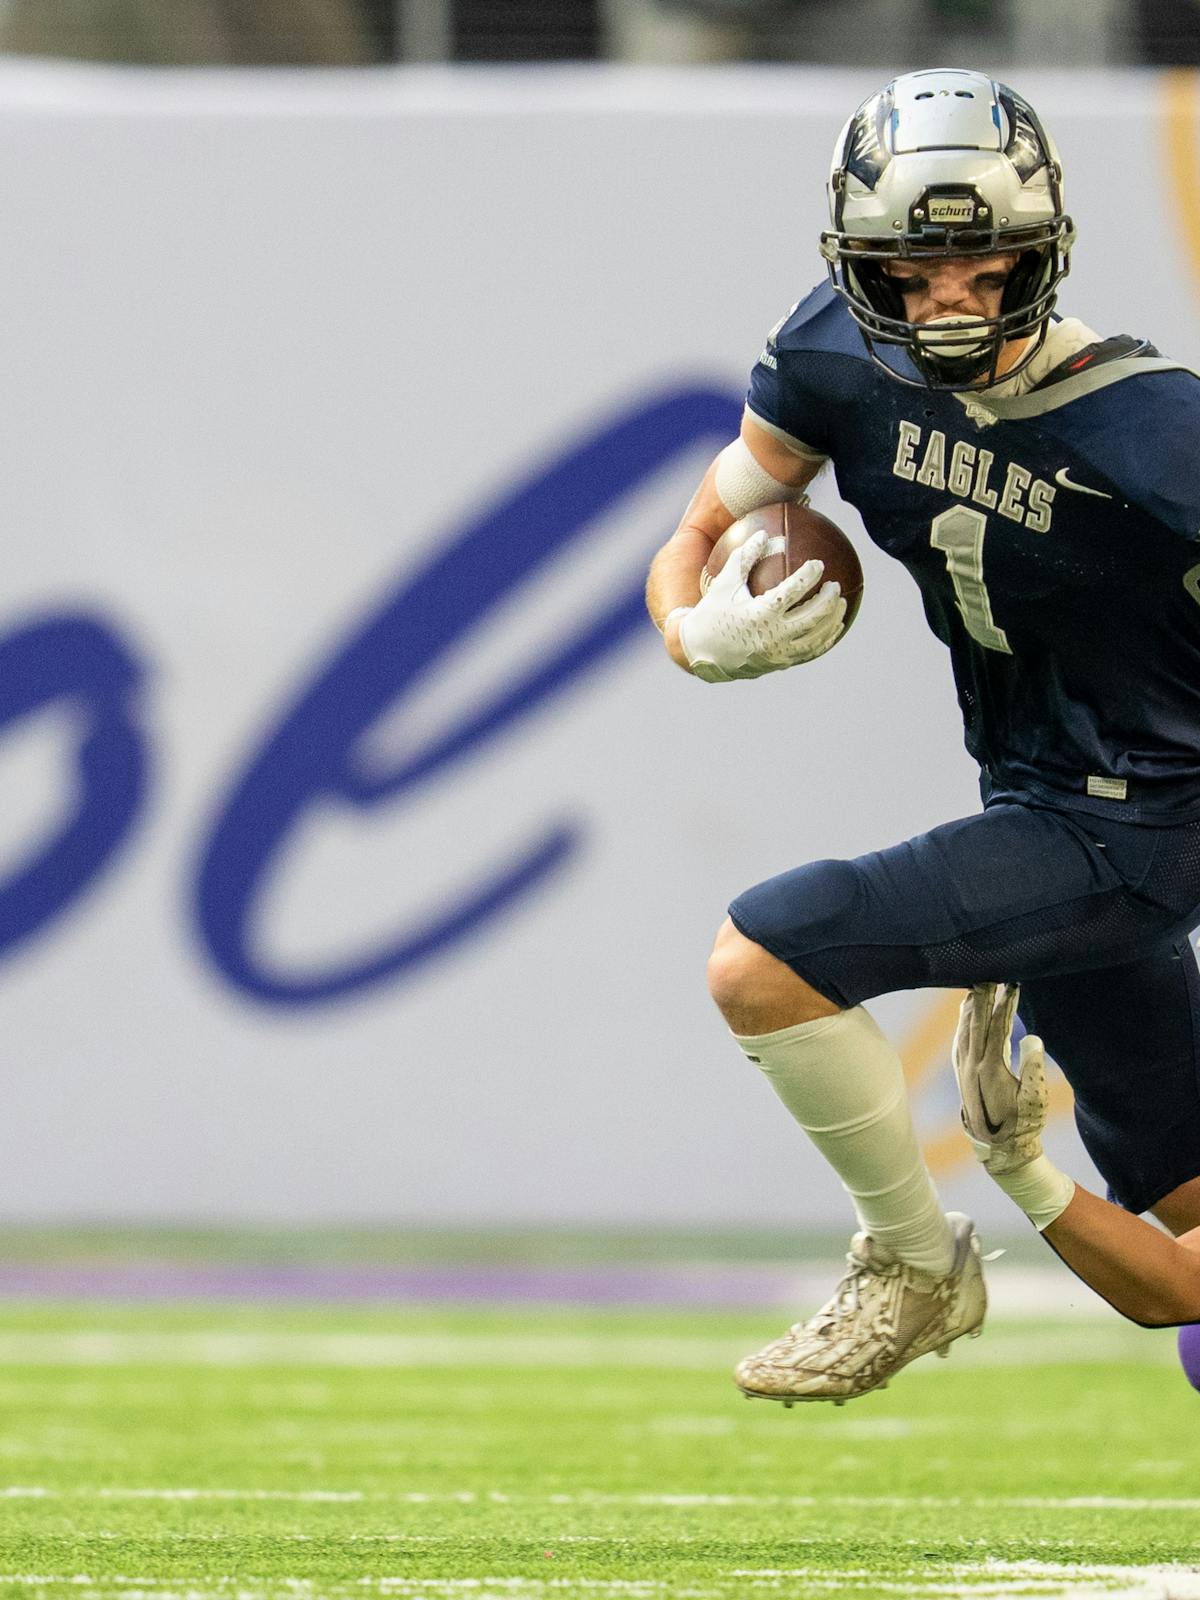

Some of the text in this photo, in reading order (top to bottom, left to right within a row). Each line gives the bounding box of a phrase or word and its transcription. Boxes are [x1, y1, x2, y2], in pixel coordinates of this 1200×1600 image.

[930, 206, 972, 216] schutt
[893, 420, 1056, 533] EAGLES
[930, 504, 1013, 655] 1
